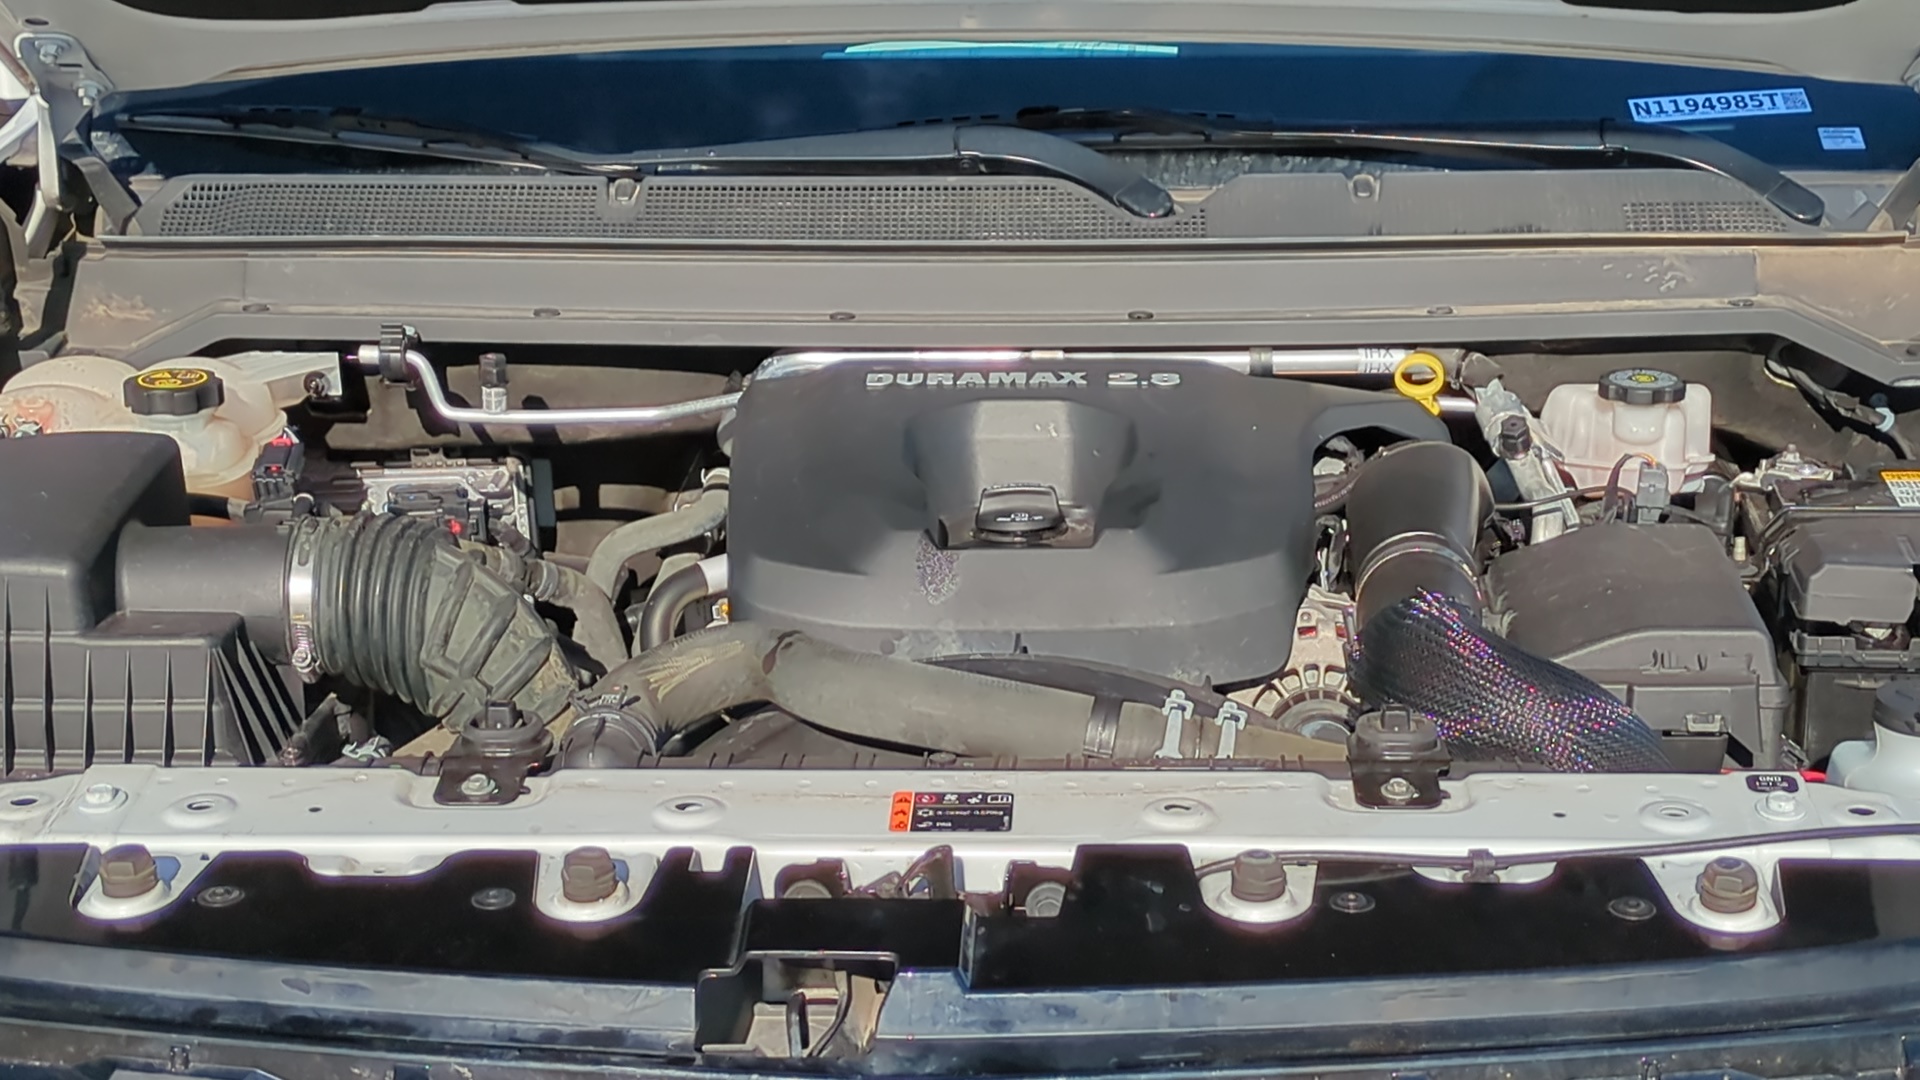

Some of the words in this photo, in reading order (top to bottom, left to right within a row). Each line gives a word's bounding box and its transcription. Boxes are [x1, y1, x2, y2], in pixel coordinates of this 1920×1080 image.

[1633, 92, 1779, 116] N1194985T
[866, 371, 1088, 386] DURAMAX
[1107, 371, 1182, 386] 2.8
